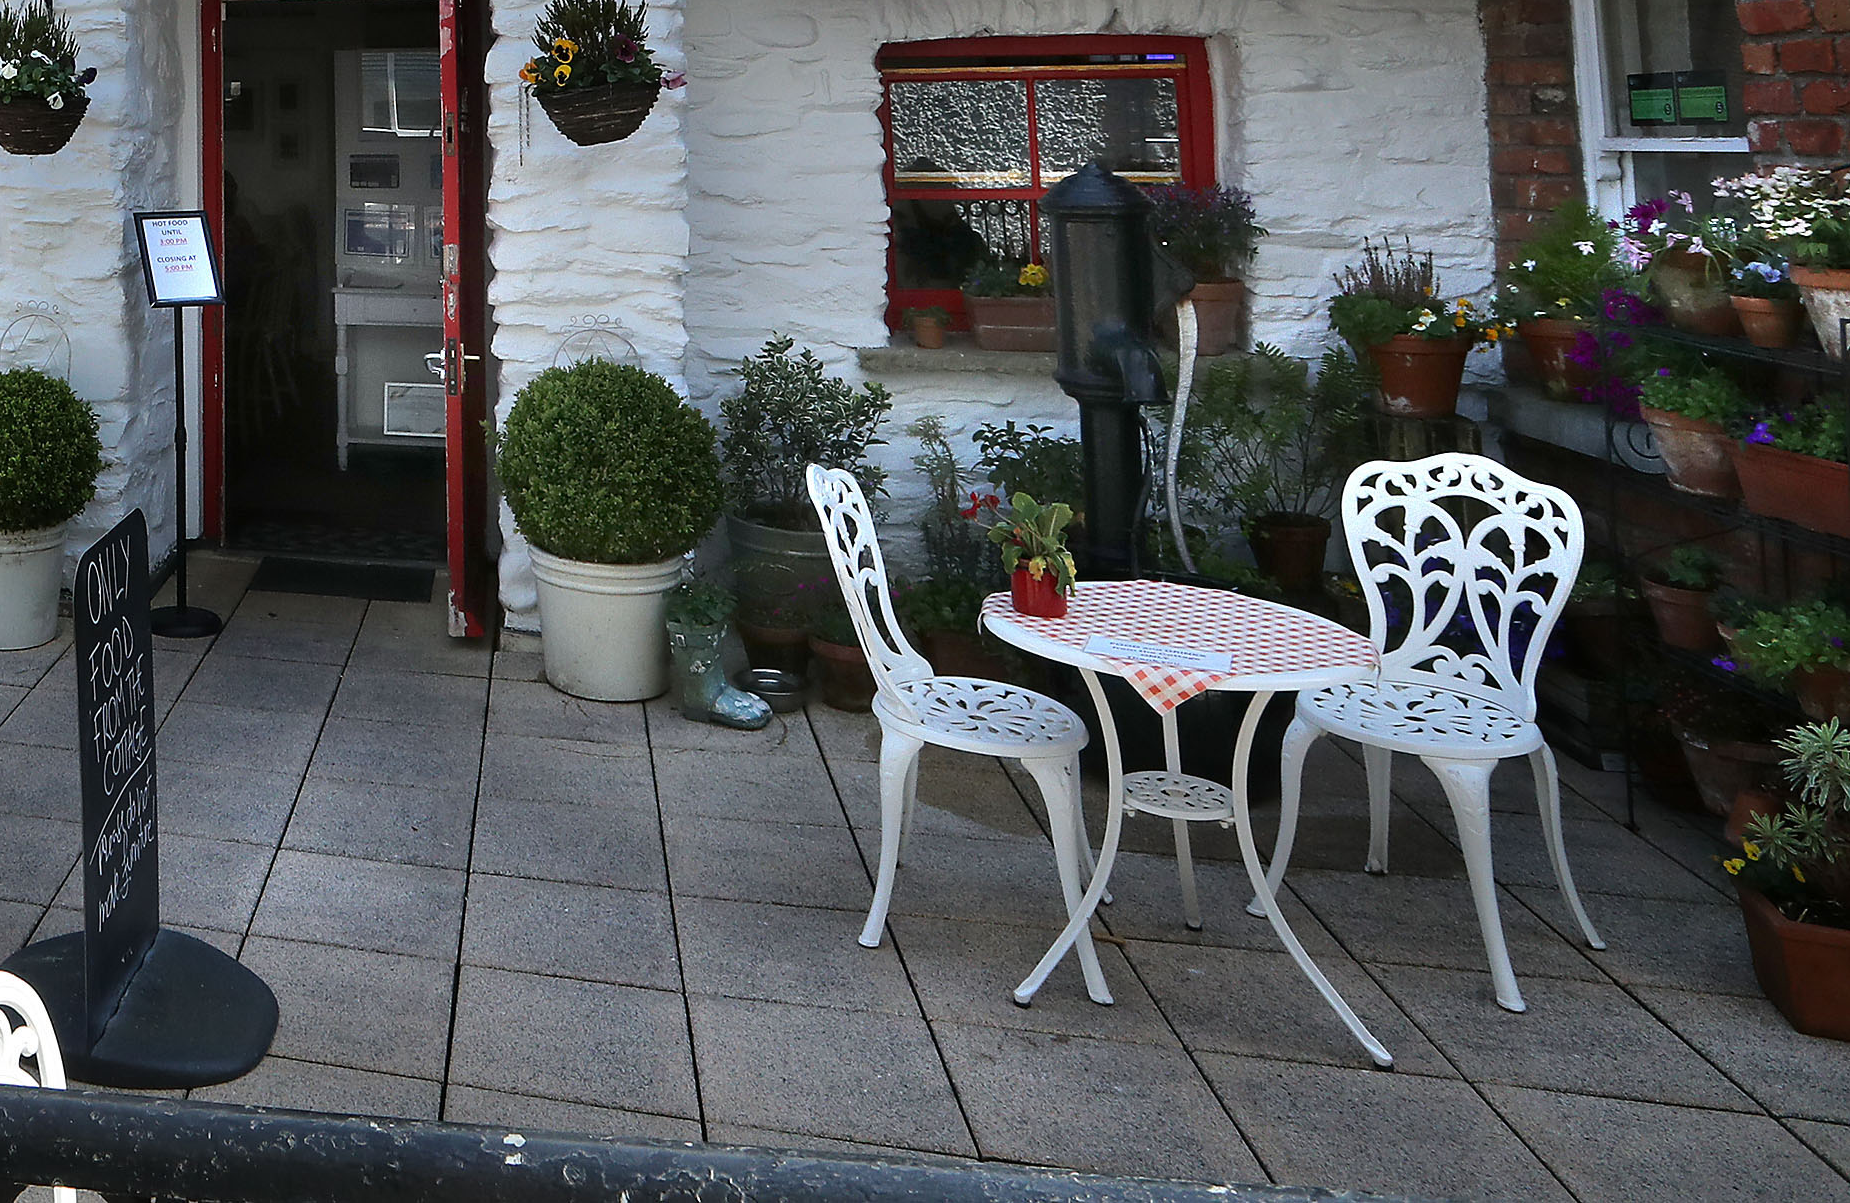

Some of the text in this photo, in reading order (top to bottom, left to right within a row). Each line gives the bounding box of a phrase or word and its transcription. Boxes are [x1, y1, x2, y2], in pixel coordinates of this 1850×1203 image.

[87, 534, 131, 624] ONLY
[88, 615, 134, 701] FOOD
[93, 653, 146, 763] FROM THE
[103, 704, 149, 796] COTTAGE
